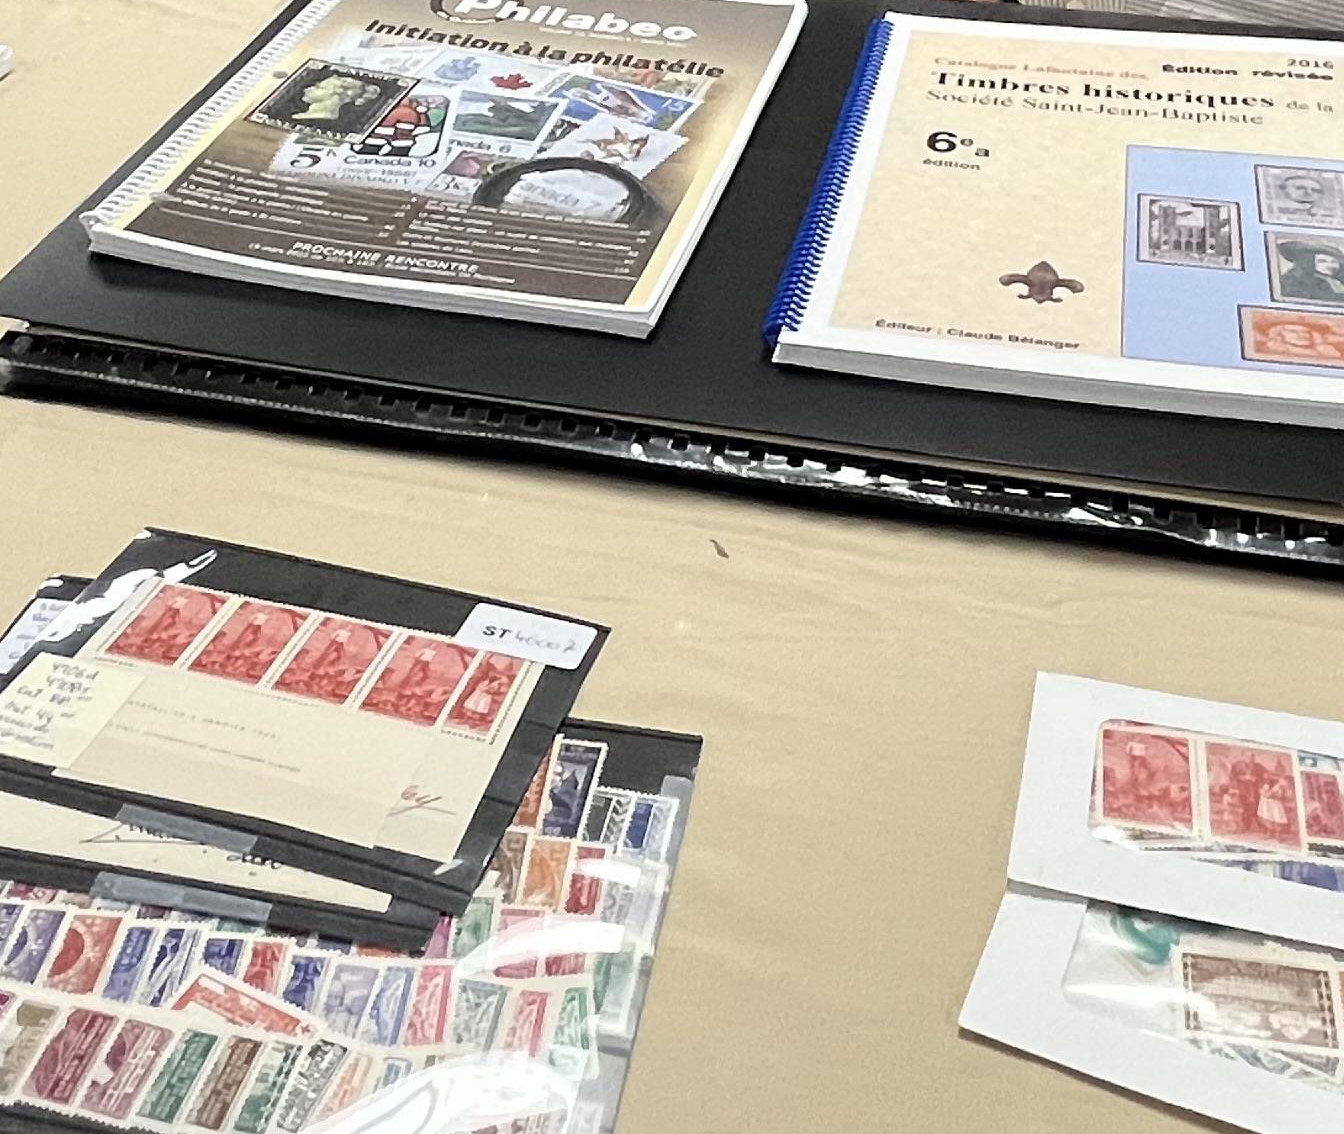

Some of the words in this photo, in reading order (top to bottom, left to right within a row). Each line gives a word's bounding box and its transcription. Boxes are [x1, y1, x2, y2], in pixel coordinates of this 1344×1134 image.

[364, 19, 508, 52] Initiation
[512, 40, 533, 57] à
[537, 43, 567, 62] la
[569, 51, 726, 78] philatélie
[1162, 63, 1238, 76] Édition
[1287, 58, 1335, 70] 2016
[931, 72, 1070, 96] Timbres
[1082, 82, 1275, 111] historiques
[1285, 100, 1310, 112] de
[1315, 101, 1334, 114] la
[925, 89, 1014, 109] Société
[1022, 96, 1264, 126] Saint-Jean-Baptiste
[448, 138, 492, 151] nada
[343, 154, 412, 167] Canada
[922, 156, 981, 171] édition
[519, 180, 580, 209] anada
[292, 241, 382, 262] PROCHAINE
[385, 254, 480, 274] RENCONTRE
[875, 319, 933, 333] Éditeur
[946, 327, 1003, 341] Claude
[1008, 334, 1081, 350] Bélanger
[483, 625, 514, 640] ST
